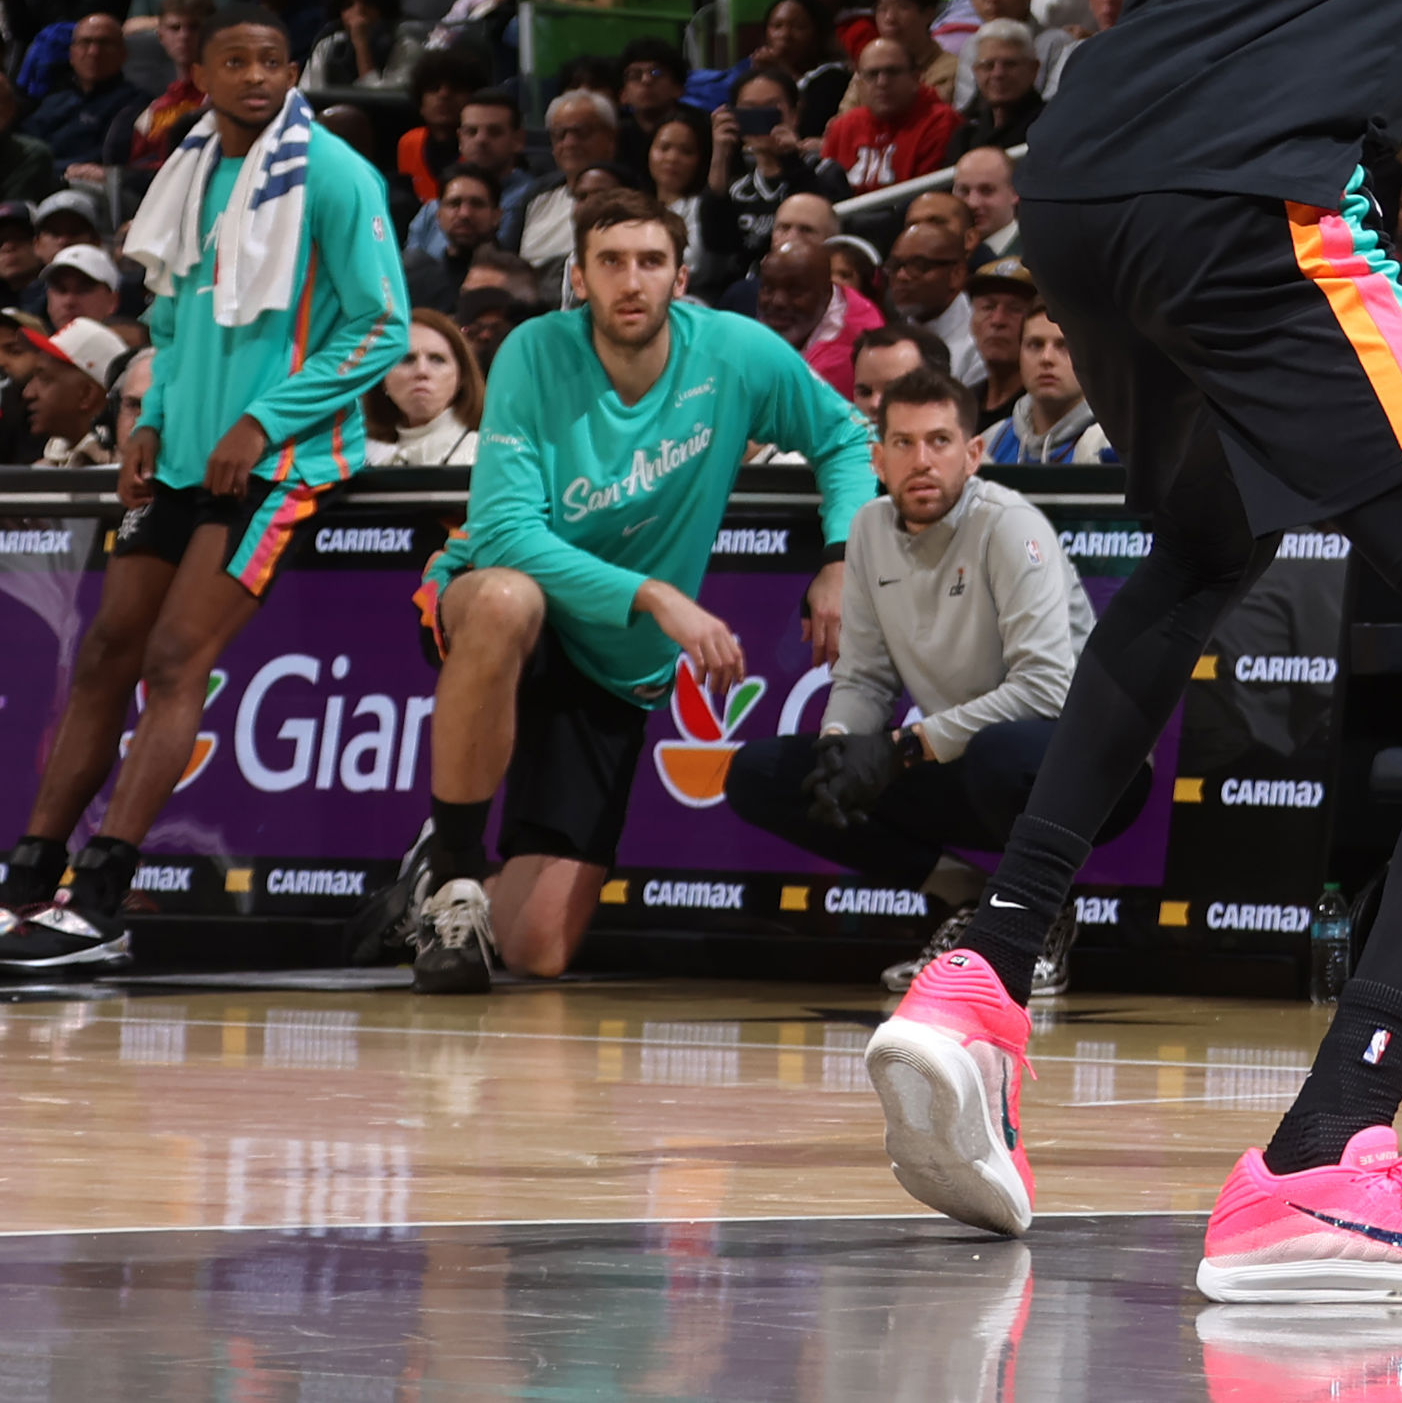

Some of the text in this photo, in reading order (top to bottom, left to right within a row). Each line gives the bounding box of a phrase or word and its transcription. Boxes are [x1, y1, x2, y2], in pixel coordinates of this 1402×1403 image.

[562, 421, 714, 523] San Antonio
[235, 653, 435, 792] Gian
